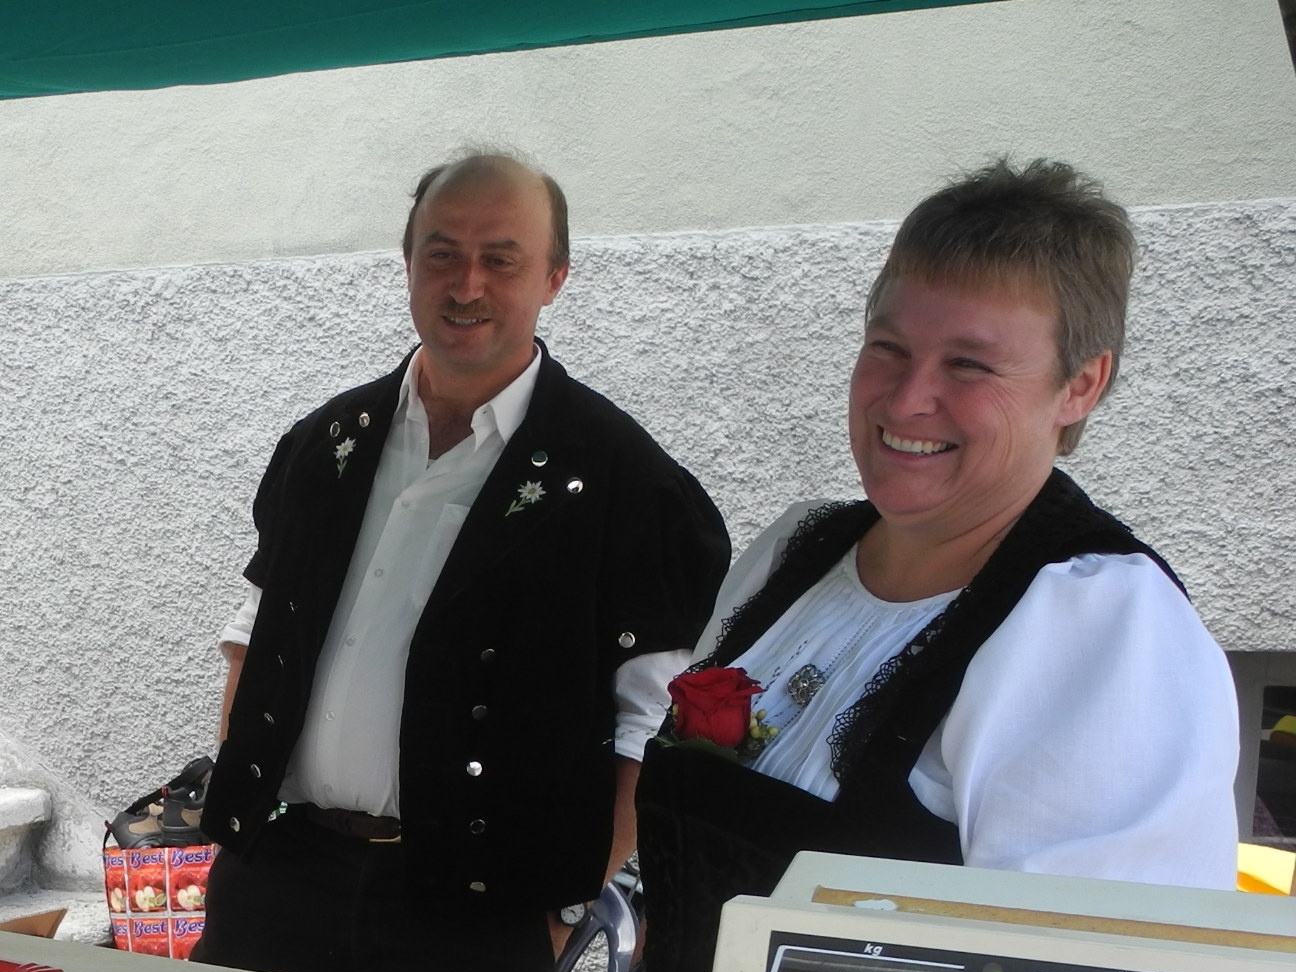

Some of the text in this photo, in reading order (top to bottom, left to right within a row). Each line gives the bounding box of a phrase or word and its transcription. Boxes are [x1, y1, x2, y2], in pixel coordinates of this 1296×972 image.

[131, 851, 165, 869] Best
[171, 848, 212, 868] Best
[133, 920, 168, 938] Best
[175, 919, 206, 937] Bes
[863, 943, 883, 957] kg
